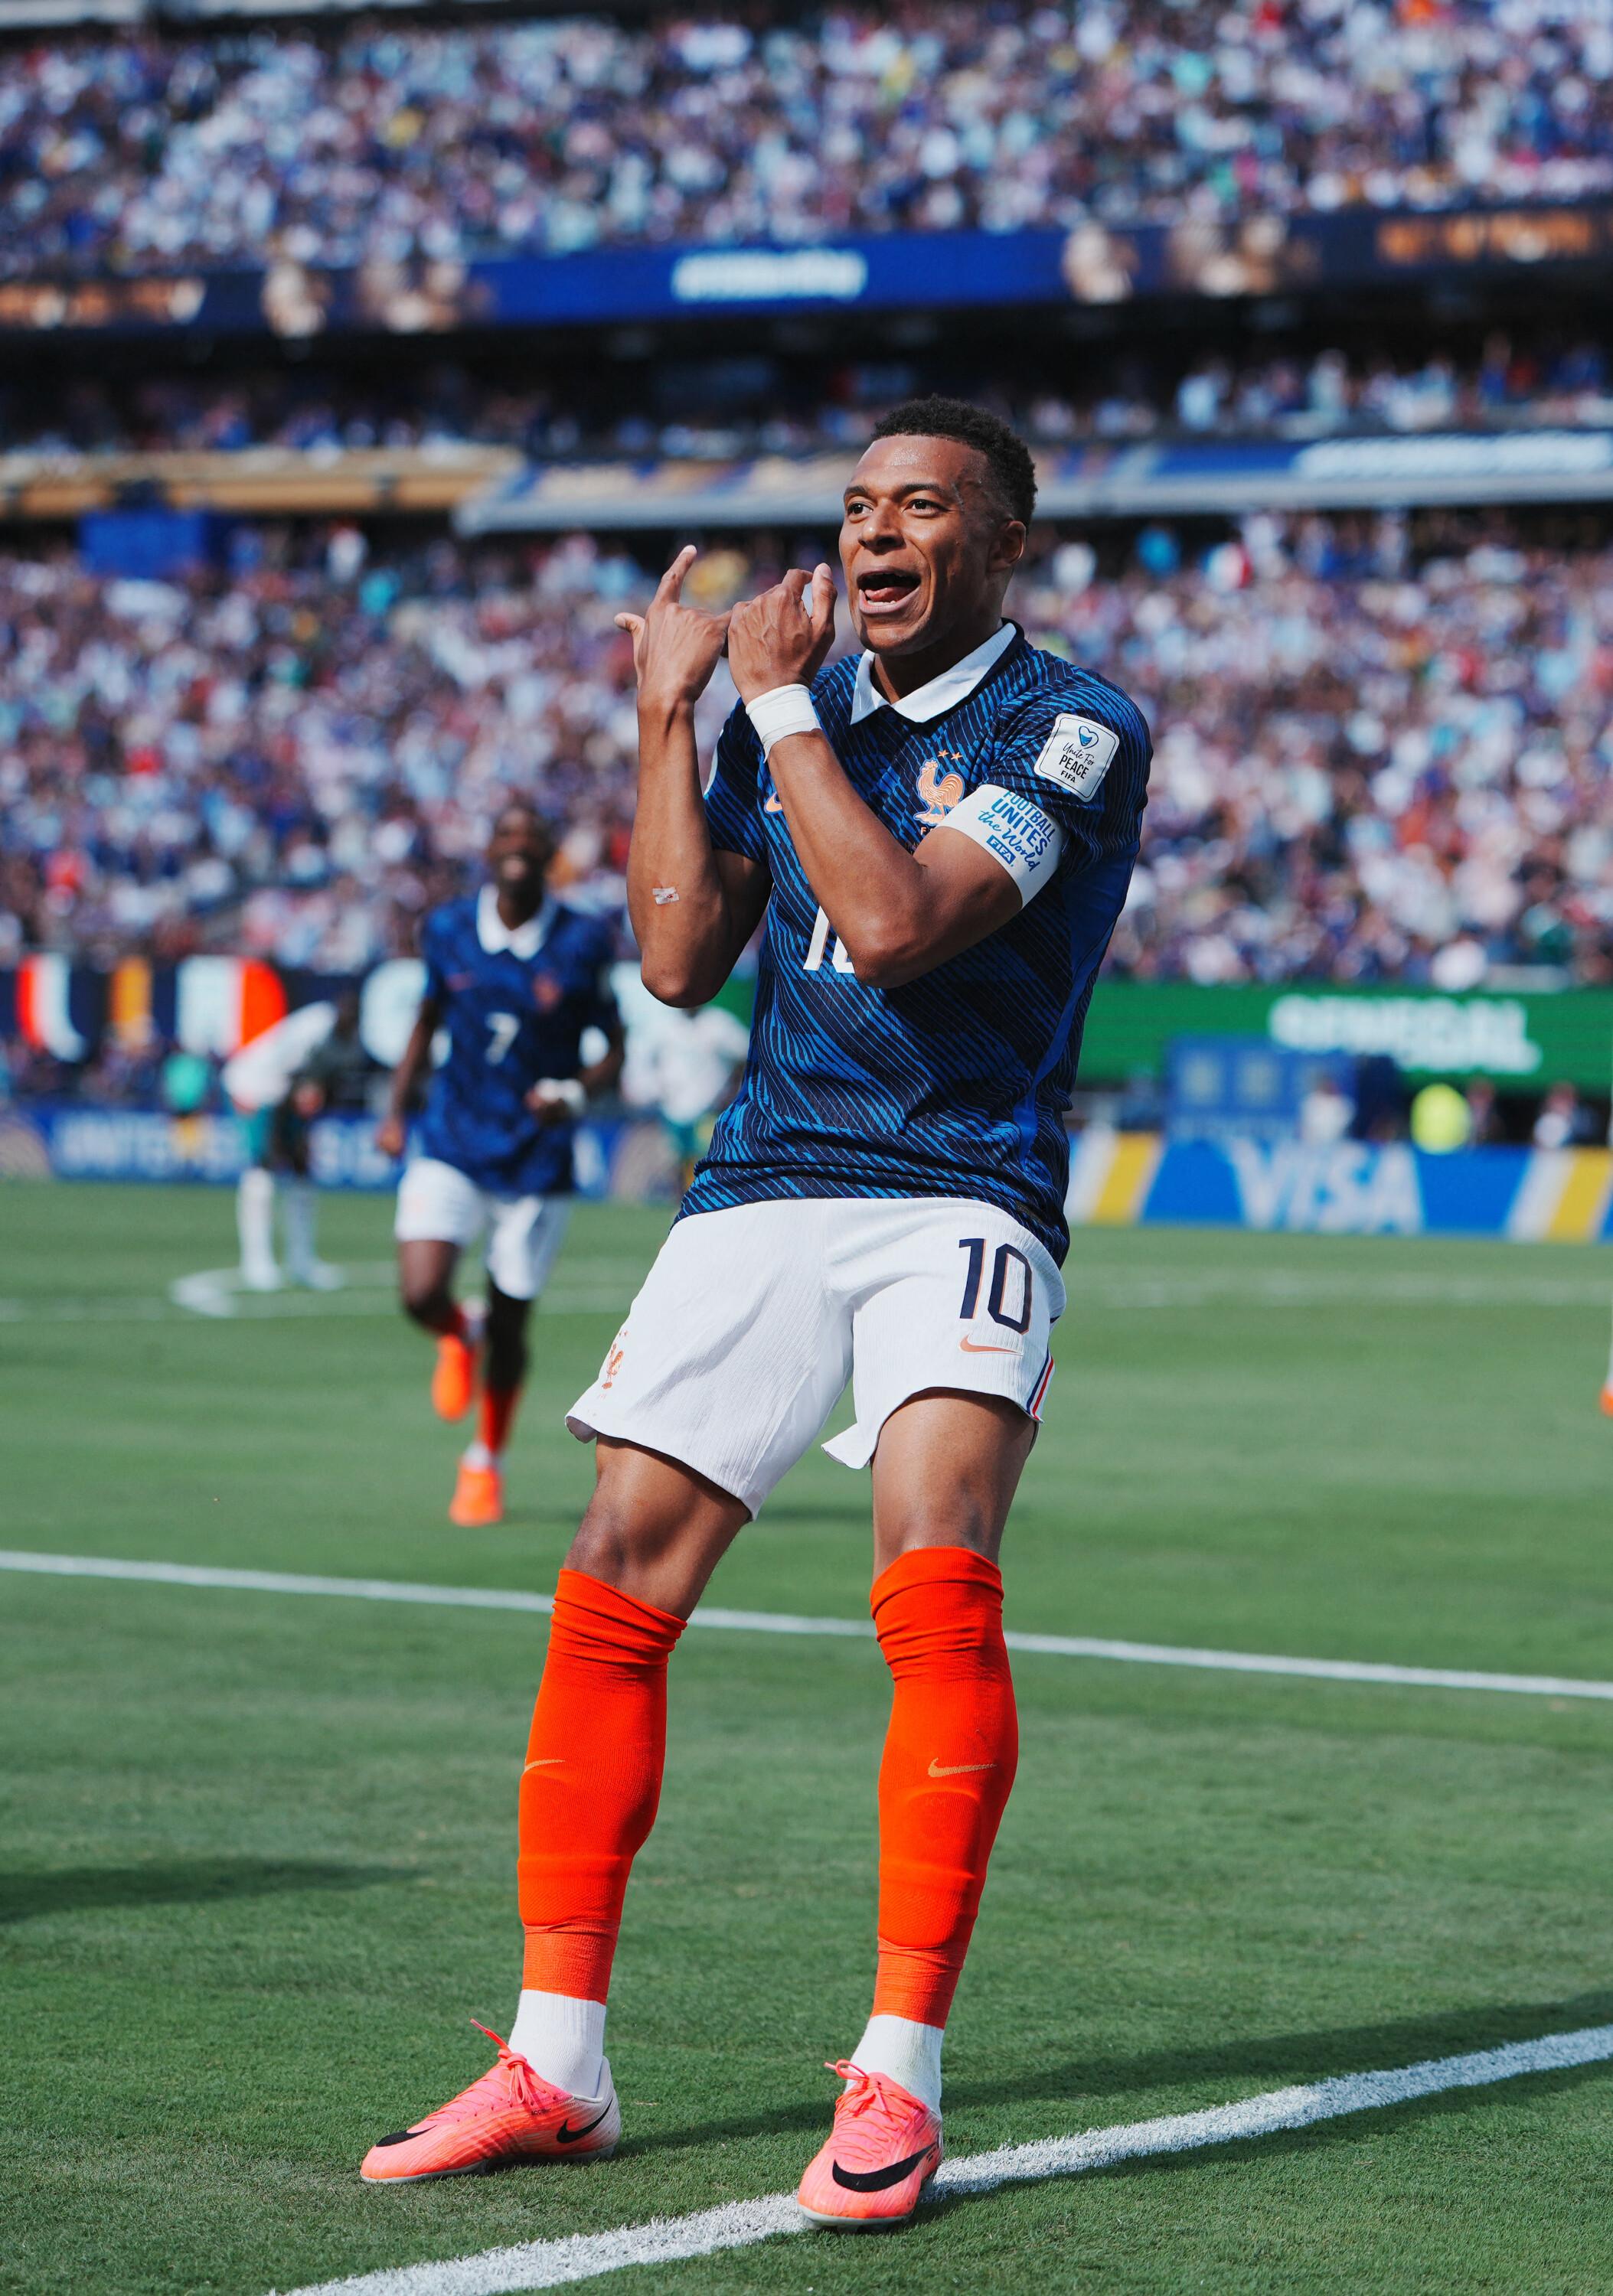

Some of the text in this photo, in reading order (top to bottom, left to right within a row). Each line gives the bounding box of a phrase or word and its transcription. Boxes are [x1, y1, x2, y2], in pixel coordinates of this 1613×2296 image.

[1059, 754, 1089, 780] PEACE
[1060, 770, 1076, 784] FIFA
[1063, 742, 1095, 766] Unite For
[978, 810, 1041, 872] the World
[991, 797, 1048, 856] UNITES
[1003, 790, 1056, 843] FOOTBALL
[988, 836, 1014, 864] FIFA
[802, 905, 856, 974] 1
[485, 1011, 521, 1067] 7
[1228, 1137, 1427, 1235] VISA
[958, 1238, 1033, 1336] 10
